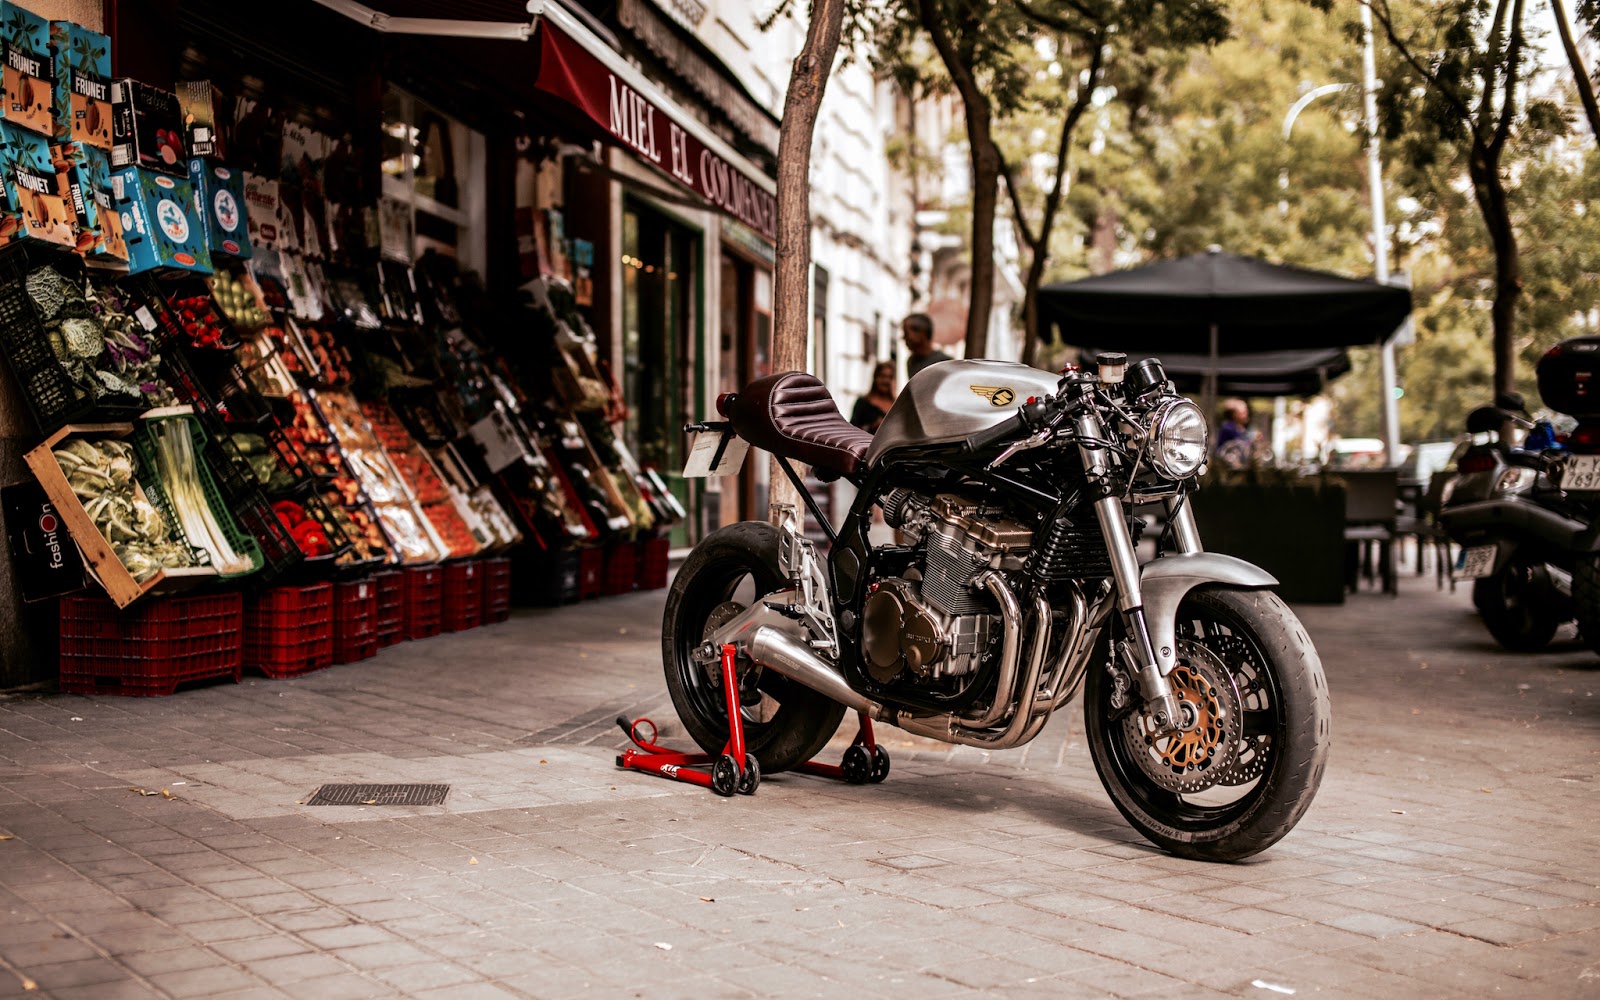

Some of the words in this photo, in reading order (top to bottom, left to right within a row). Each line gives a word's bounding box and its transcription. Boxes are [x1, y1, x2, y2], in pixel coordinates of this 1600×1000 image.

[8, 50, 41, 78] FRUNET
[75, 76, 107, 101] FRUNET
[609, 74, 661, 163] MIEL
[670, 122, 693, 185] EL
[15, 169, 50, 194] FRUNET
[70, 183, 86, 215] FRUNET
[39, 502, 64, 569] fashion
[1132, 809, 1174, 838] MICHELIN
